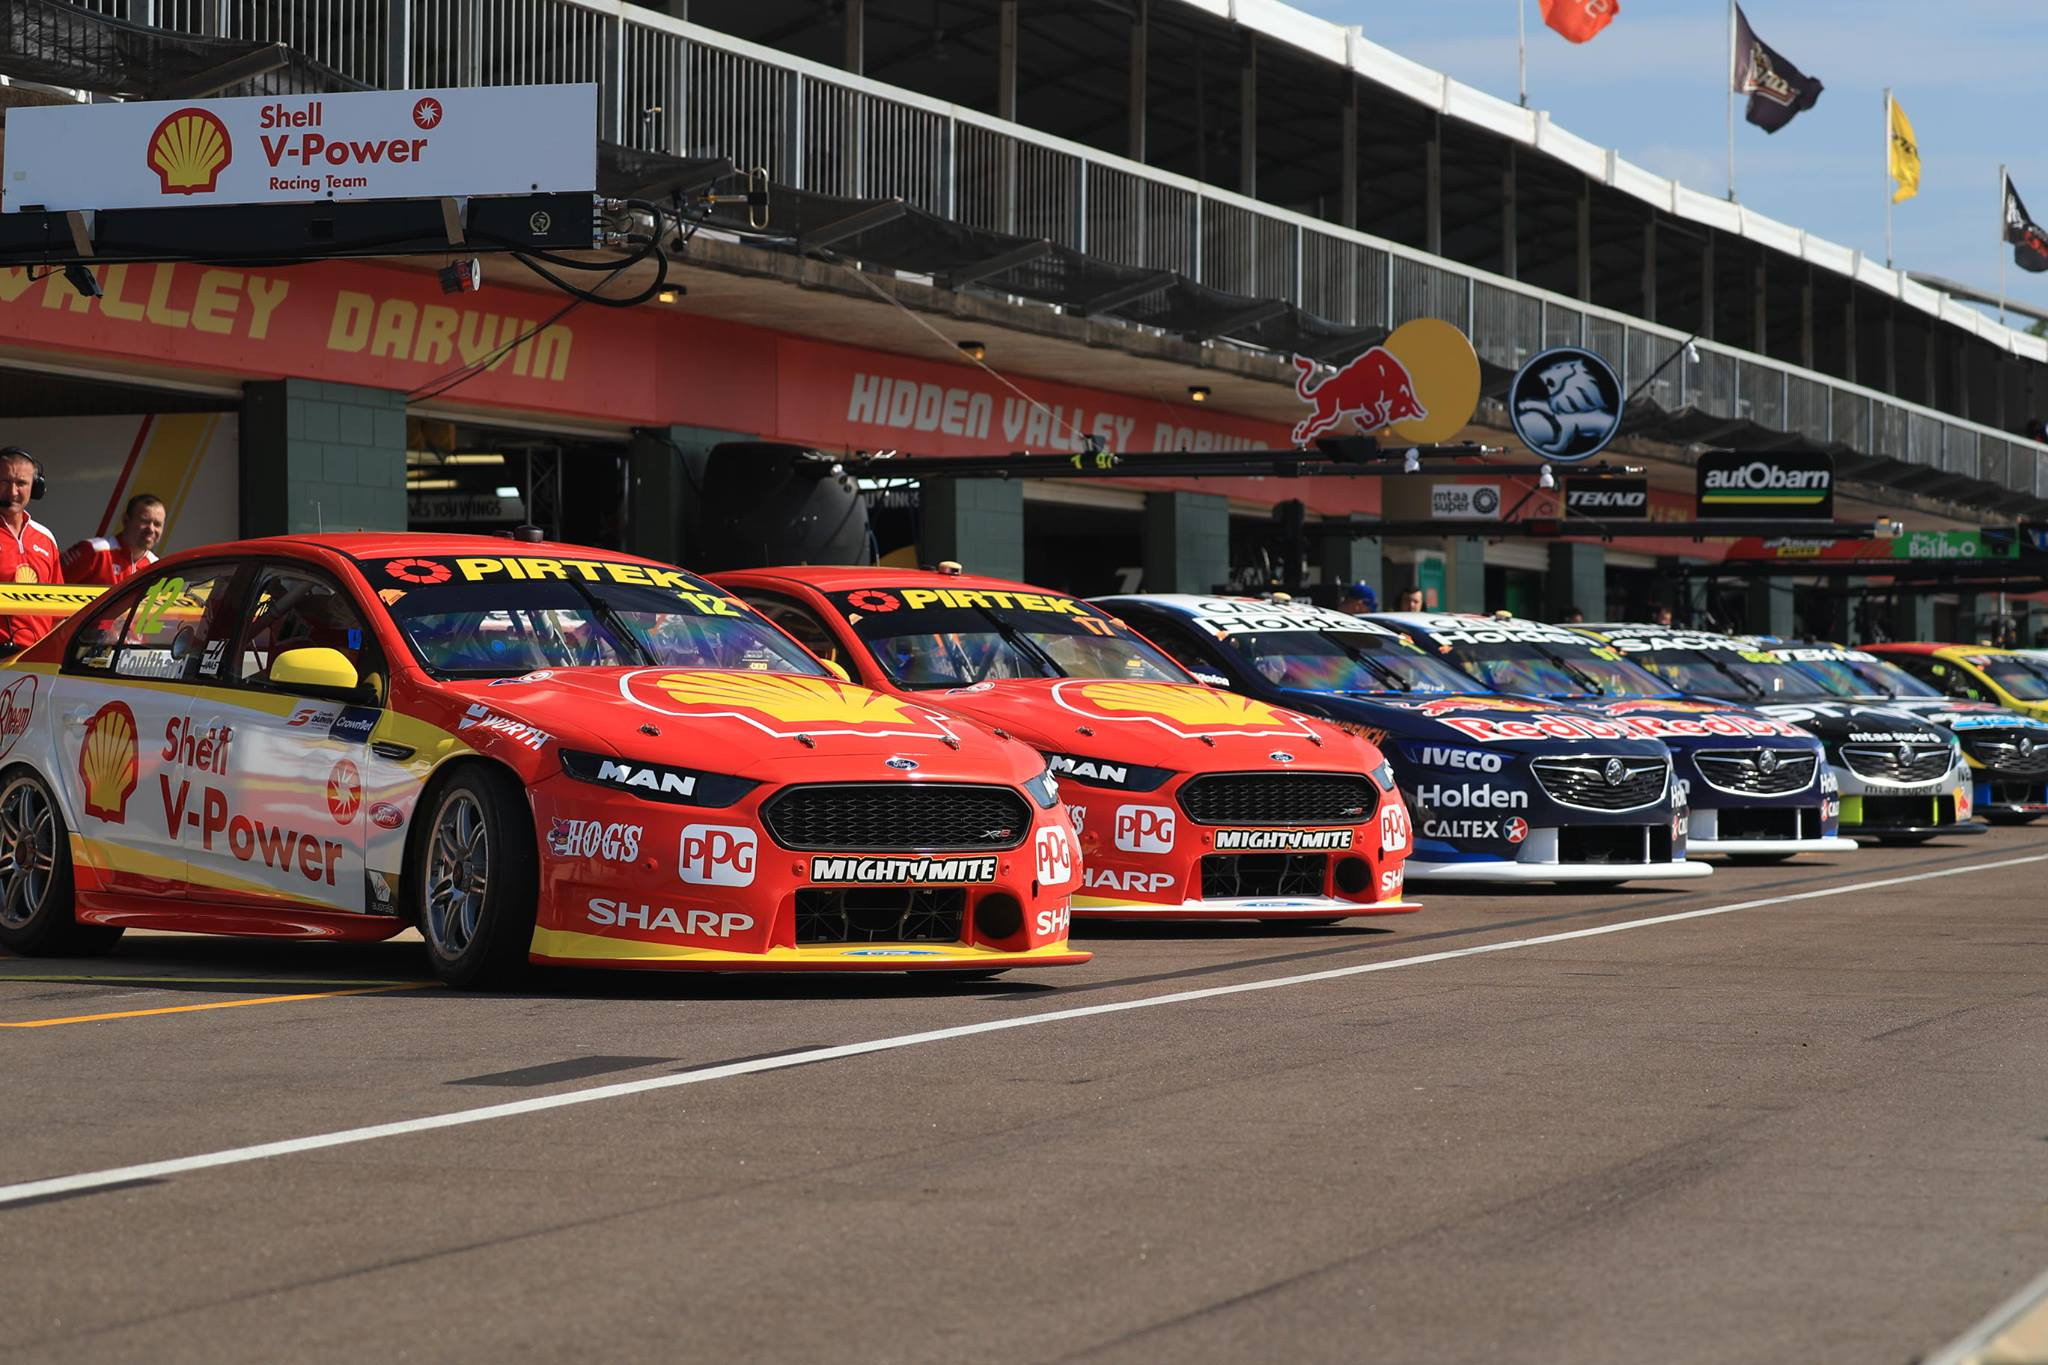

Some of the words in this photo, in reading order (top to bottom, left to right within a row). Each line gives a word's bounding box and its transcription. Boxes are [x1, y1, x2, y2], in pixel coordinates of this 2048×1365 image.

[260, 102, 322, 129] Shell
[260, 134, 428, 168] V-Power
[269, 176, 320, 191] Racing
[325, 174, 367, 188] Team
[327, 289, 573, 382] DARWIN
[847, 372, 993, 440] HIDDEN
[1002, 402, 1136, 452] VALLEY
[1152, 422, 1269, 452] DAR
[1433, 488, 1468, 502] mtaa
[1433, 502, 1470, 514] super
[1568, 490, 1645, 507] TEKNO
[456, 557, 703, 592] PIRTEK
[135, 577, 185, 634] 12
[677, 591, 742, 617] 12
[901, 590, 1089, 616] PIRTEK
[1071, 616, 1117, 637] 17
[1429, 631, 1601, 647] Holden
[161, 716, 232, 776] Shell
[477, 714, 552, 751] WÜRTH
[1049, 755, 1127, 783] MAN
[1422, 747, 1501, 773] IVECO
[597, 760, 697, 797] MAN
[1417, 784, 1528, 808] Holden
[160, 774, 342, 886] V-Power
[567, 819, 643, 863] HOG'S
[1119, 810, 1173, 848] PPG
[1217, 831, 1352, 850] MIGHTYMITE
[1423, 819, 1499, 839] CALTEX
[683, 830, 754, 879] PPG
[1038, 831, 1069, 879] PPG
[813, 857, 995, 882] MIGHTYMITE
[1083, 868, 1175, 893] HARP
[587, 898, 755, 938] SHARP
